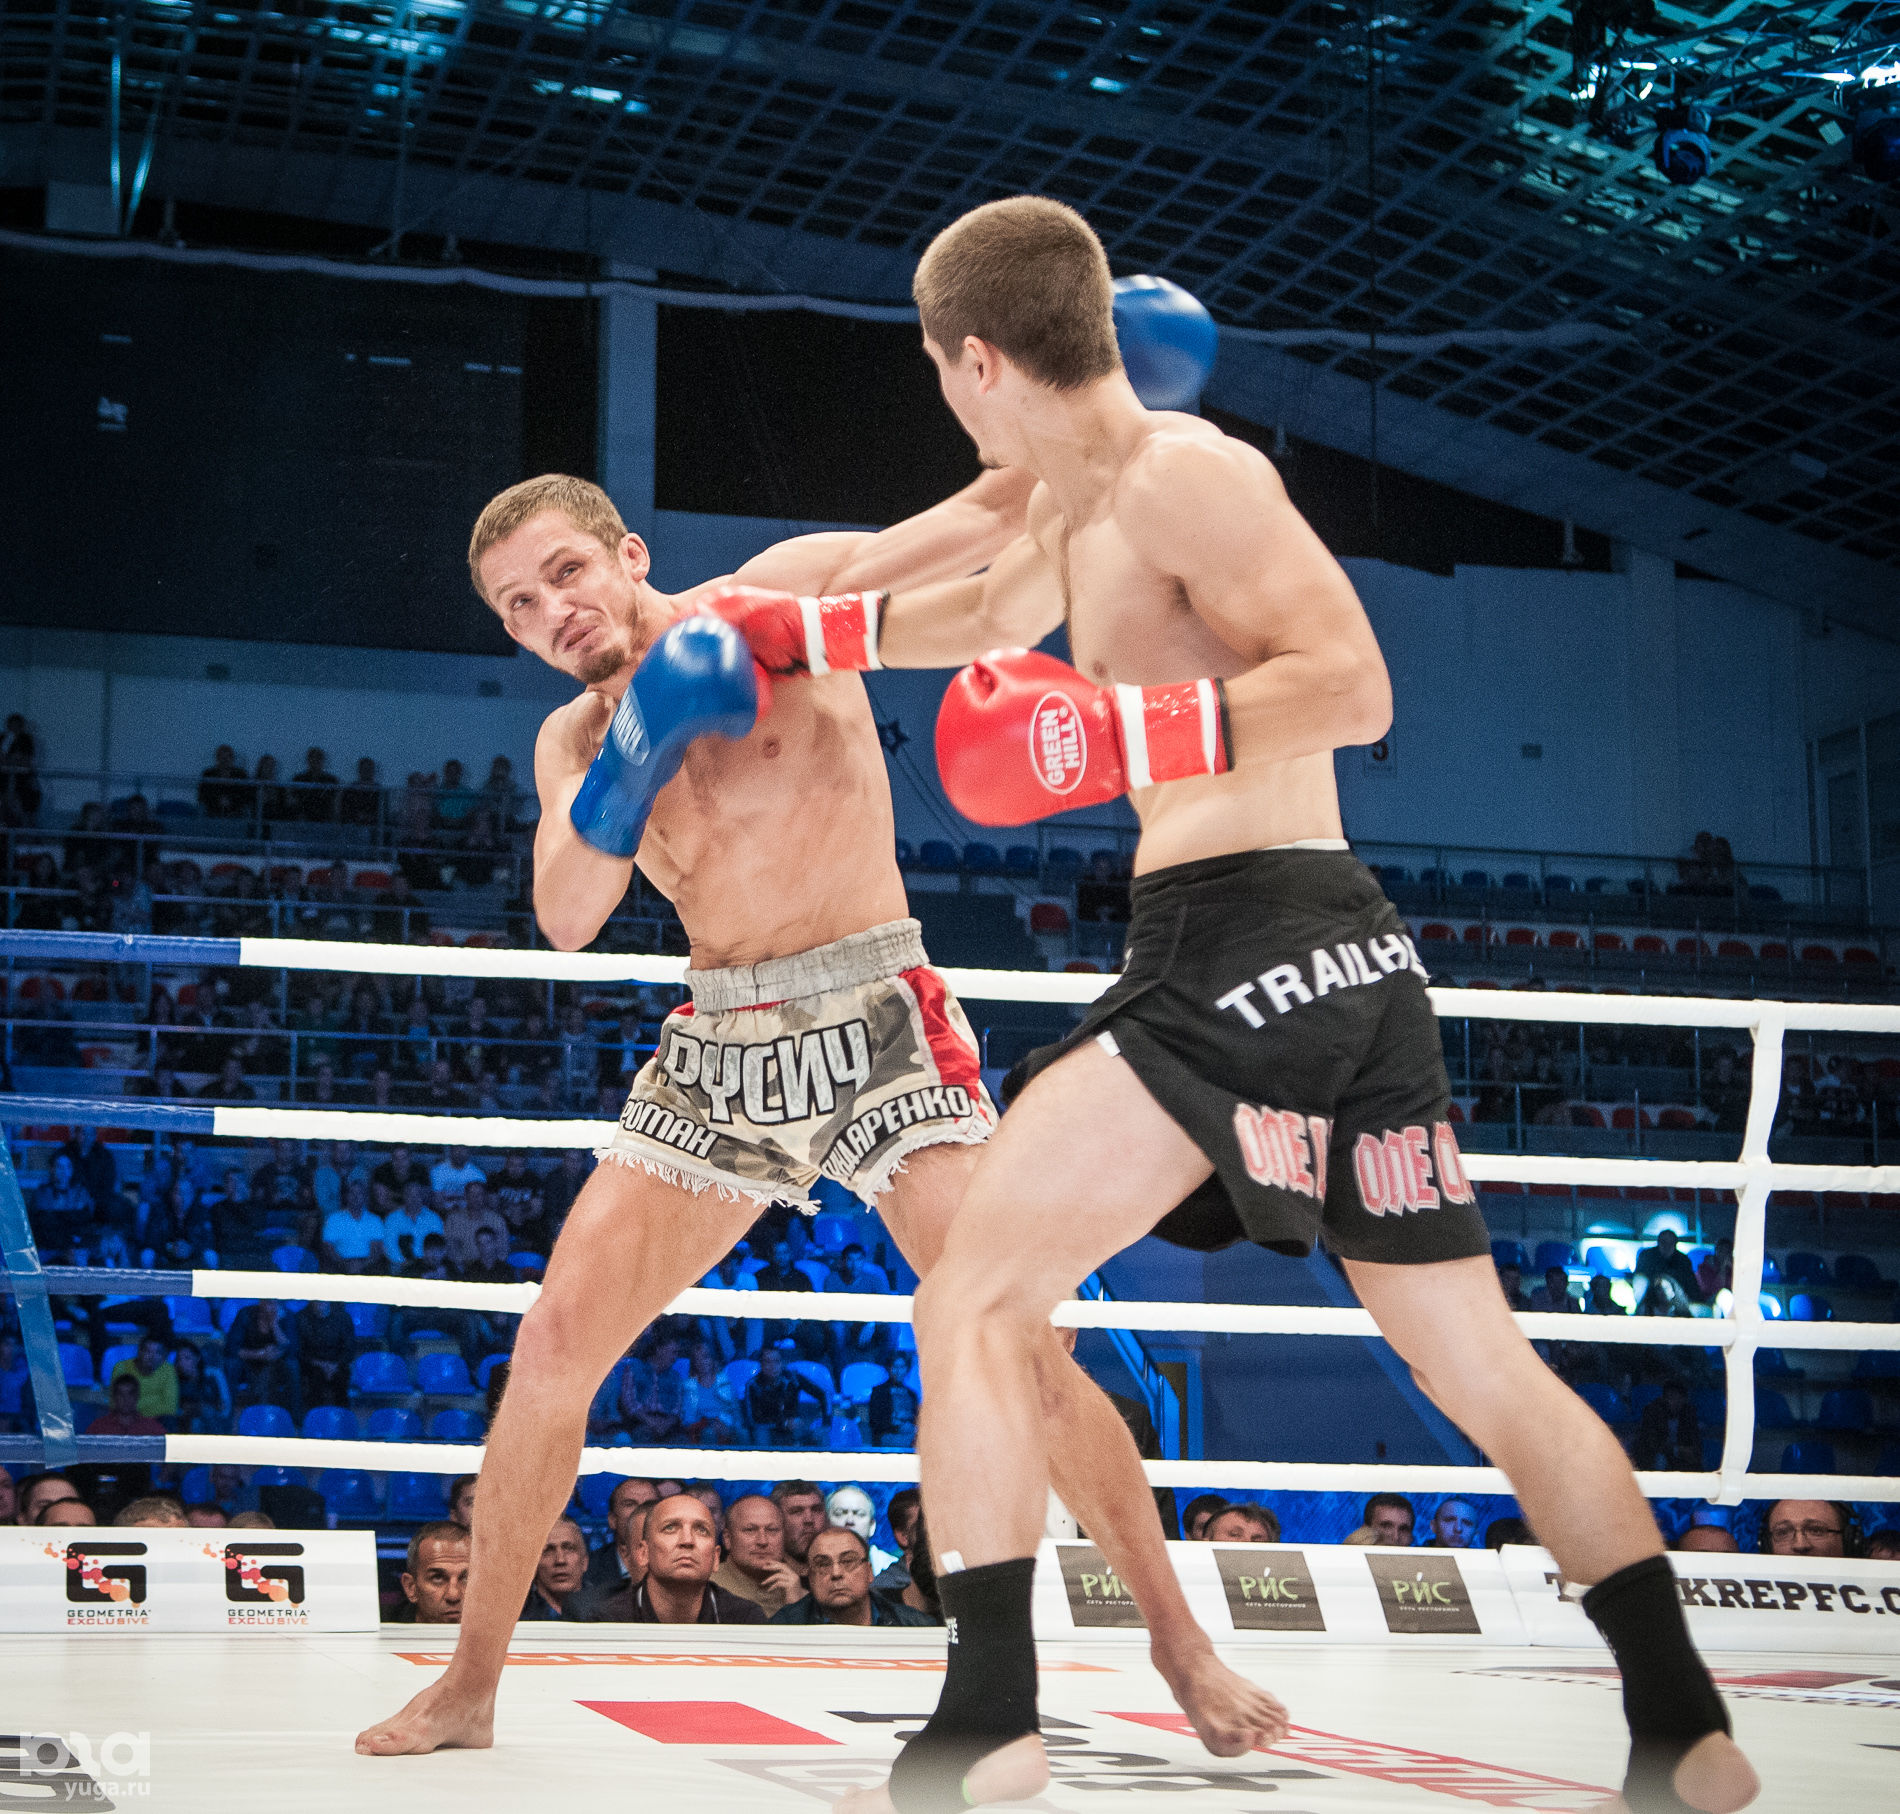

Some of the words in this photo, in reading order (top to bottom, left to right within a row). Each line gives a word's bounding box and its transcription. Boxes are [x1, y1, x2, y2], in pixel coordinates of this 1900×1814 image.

[1040, 708, 1066, 785] GREEN
[1060, 715, 1081, 770] HILL
[662, 1018, 872, 1125] РУСИЧ
[1080, 1566, 1132, 1599] РИ
[67, 1609, 148, 1618] GEOMETRIA
[67, 1617, 150, 1626] EXCLUSIVE
[227, 1608, 307, 1618] GEOMETRIA
[228, 1617, 310, 1626] EXCLUSIVE
